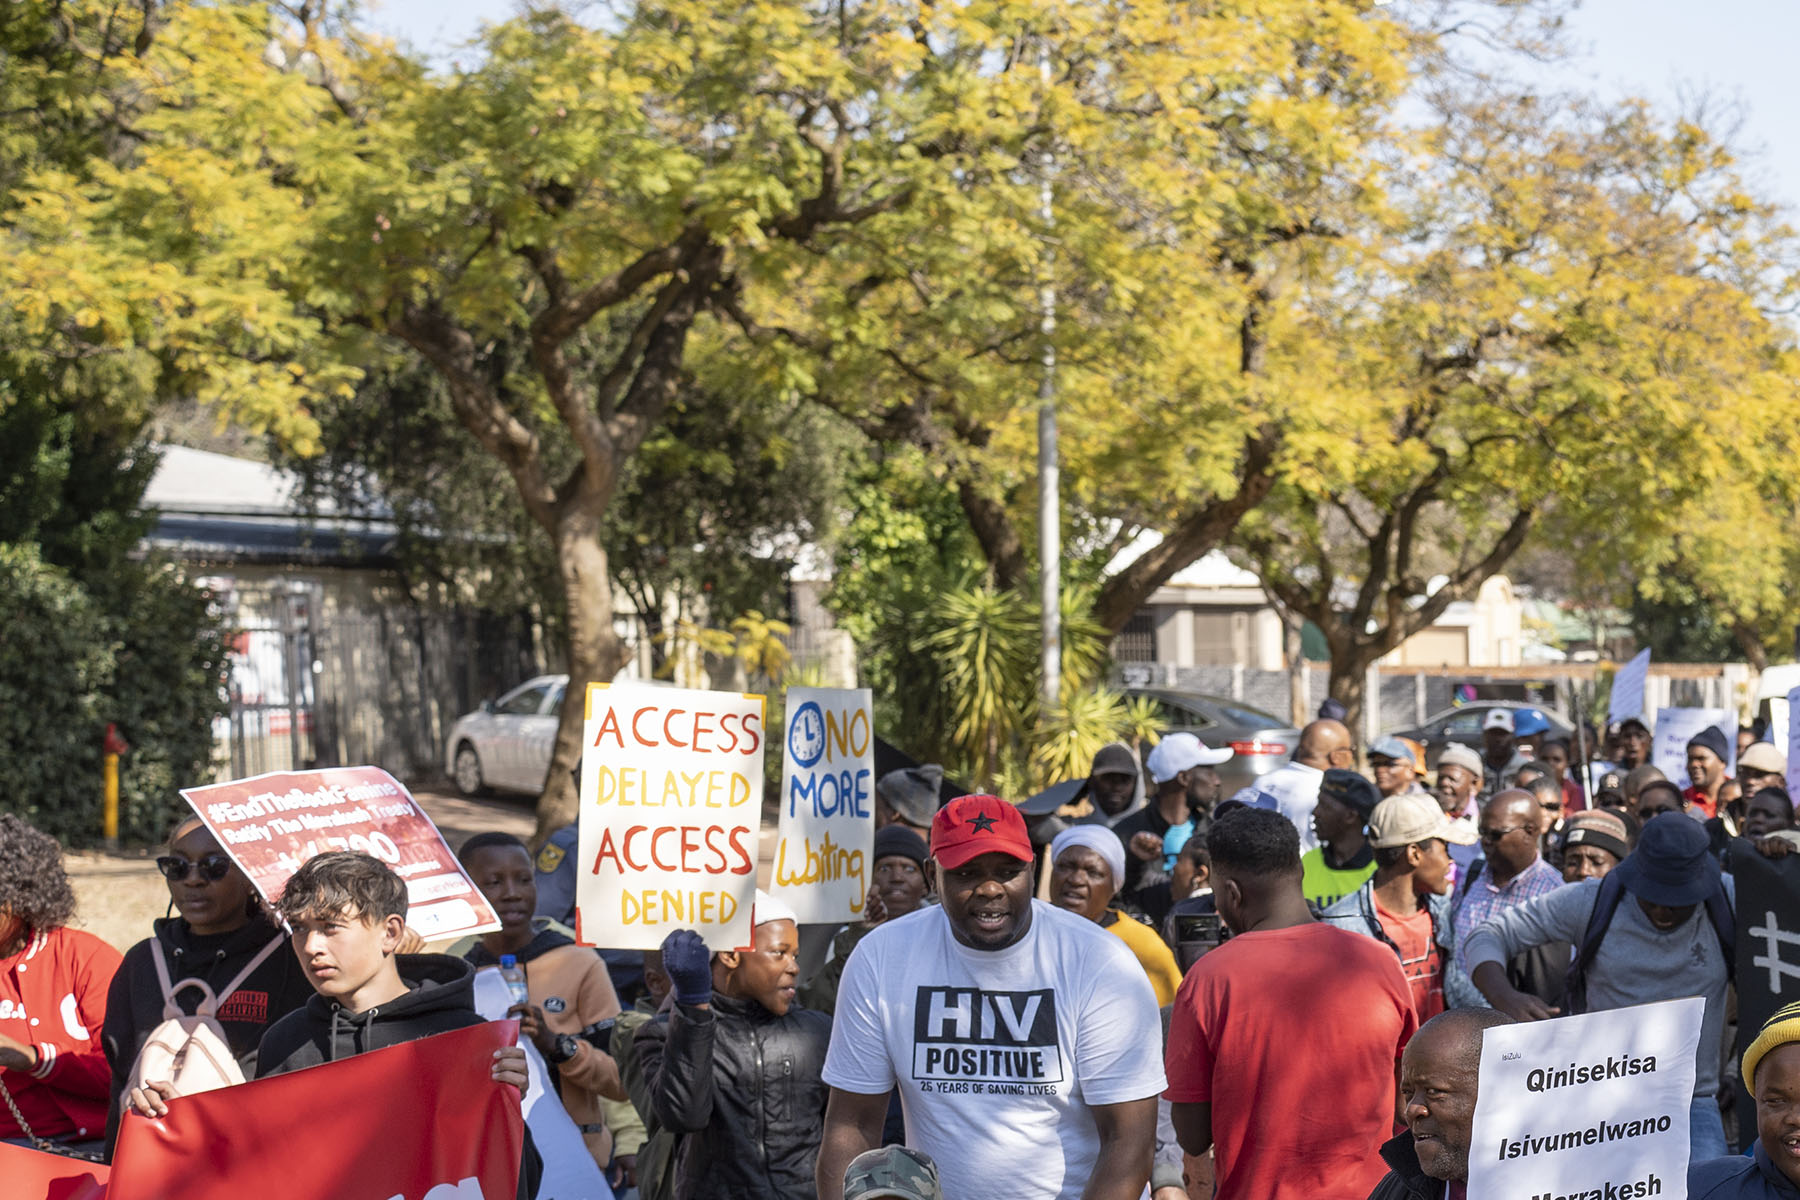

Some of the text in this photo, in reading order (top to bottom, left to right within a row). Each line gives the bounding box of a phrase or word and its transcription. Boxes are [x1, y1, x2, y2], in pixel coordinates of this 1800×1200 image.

[594, 706, 759, 755] ACCESS
[826, 708, 870, 763] NO
[207, 781, 398, 824] #EndTheBookFamine
[596, 765, 751, 808] DELAYED
[790, 768, 870, 818] MORE
[222, 822, 272, 844] Ratify
[268, 815, 302, 836] The
[367, 801, 415, 821] Treaty
[592, 825, 752, 875] ACCESS
[776, 830, 864, 913] Waiting
[621, 889, 737, 925] DENIED
[927, 991, 1043, 1042] HIV
[926, 1048, 1045, 1078] POSITIVE
[1526, 1054, 1657, 1093] Qinisekisa
[920, 1081, 1057, 1096] 25 YEARS OF SAVING LIVES
[1498, 1114, 1671, 1160] Isivumelwano
